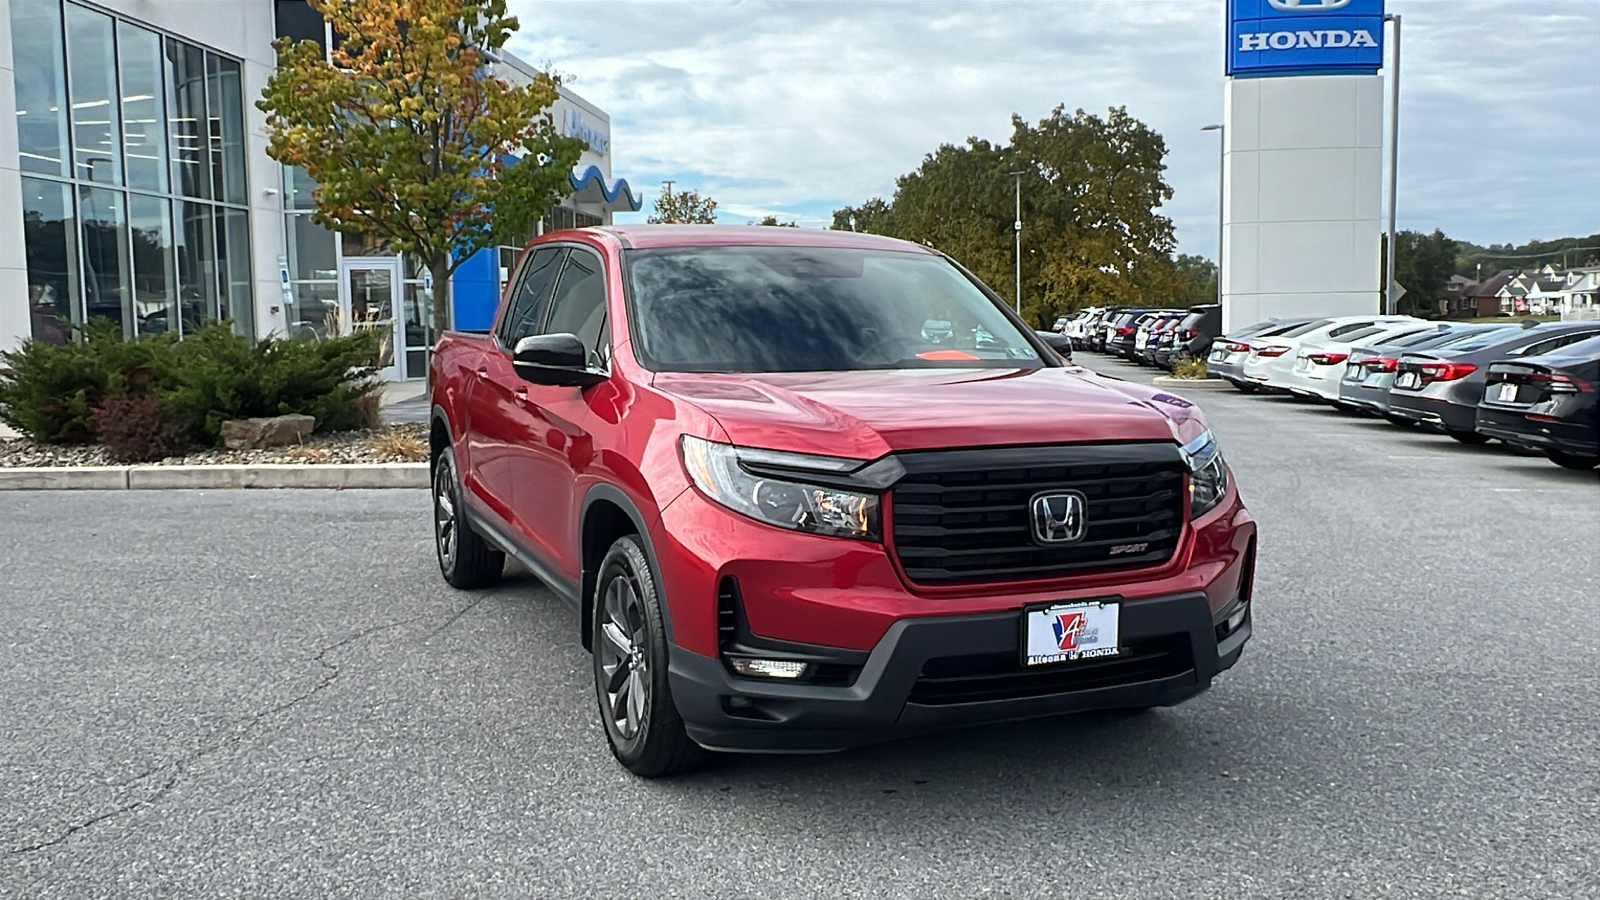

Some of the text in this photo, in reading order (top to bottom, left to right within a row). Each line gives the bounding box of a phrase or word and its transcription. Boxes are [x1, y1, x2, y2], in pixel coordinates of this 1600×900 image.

[1239, 30, 1378, 52] HONDA
[1109, 542, 1149, 555] SPORT
[1027, 647, 1120, 666] Altoona HONDA
